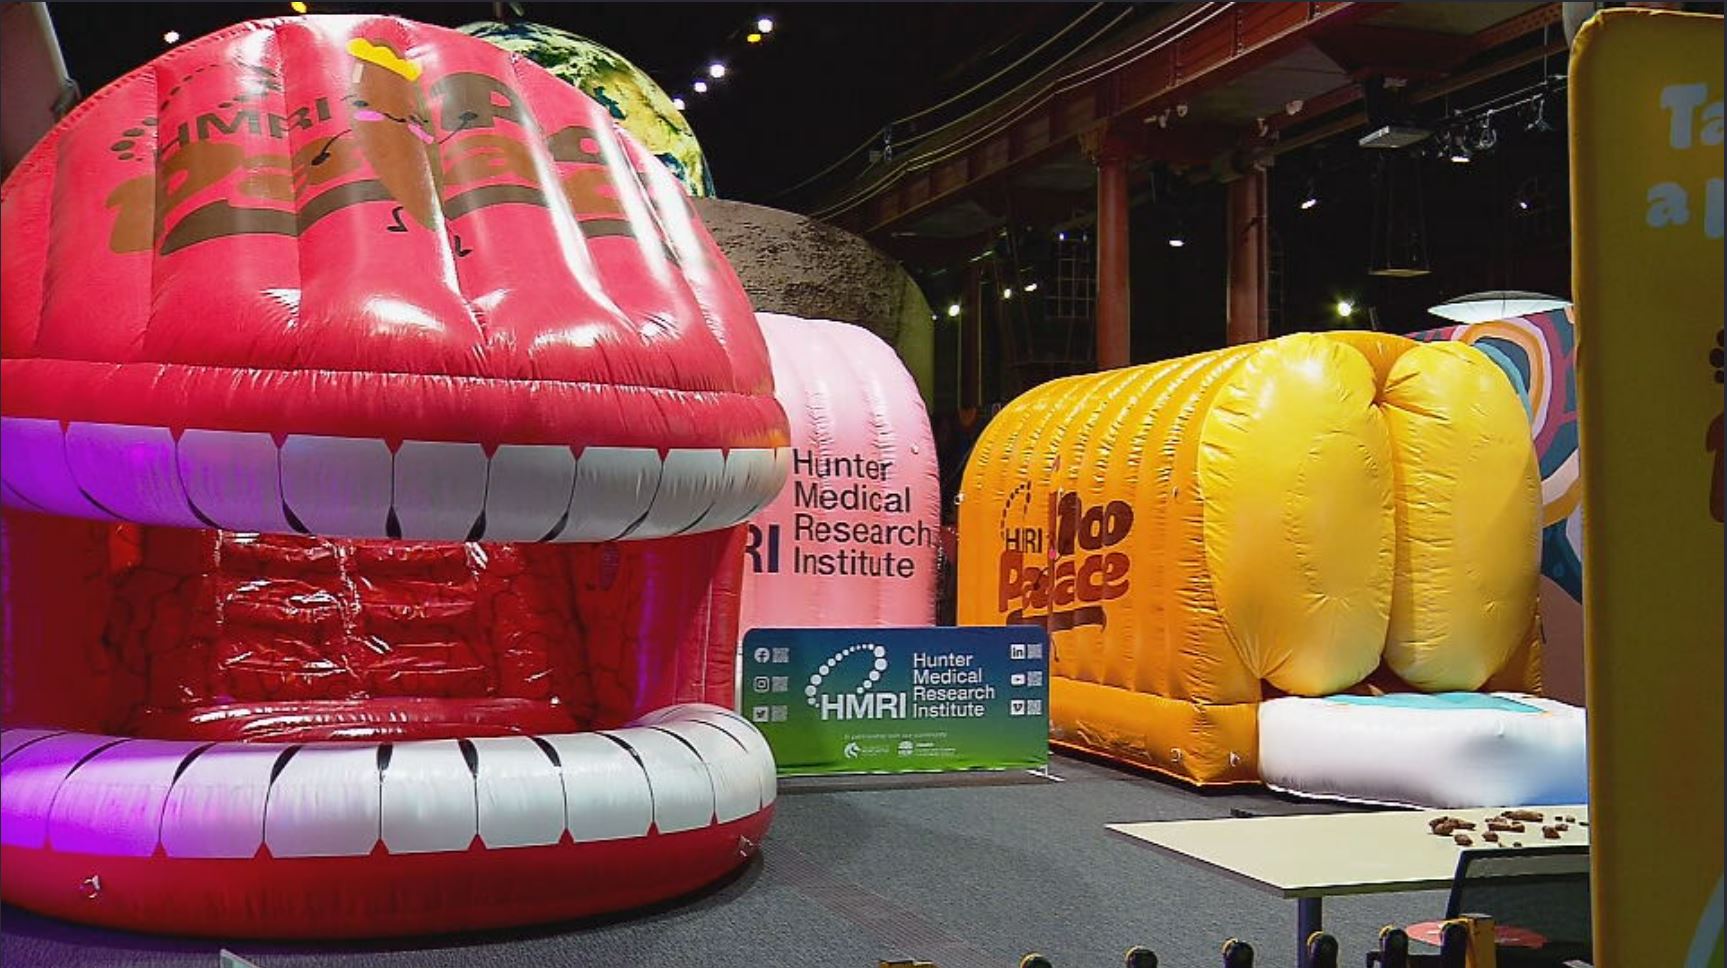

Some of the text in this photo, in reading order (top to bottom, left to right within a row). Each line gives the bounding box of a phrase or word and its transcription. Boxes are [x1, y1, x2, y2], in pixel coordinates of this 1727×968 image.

[158, 97, 332, 152] HMRI
[1647, 181, 1690, 228] a
[793, 448, 893, 481] Hunter
[794, 481, 910, 513] Medical
[794, 513, 932, 546] Research
[1006, 527, 1042, 553] HRI
[794, 546, 915, 578] Institute
[998, 551, 1131, 613] Paace
[913, 652, 973, 668] Hunter
[913, 668, 982, 685] Medical
[913, 684, 996, 701] Research
[821, 692, 906, 720] HMRI
[913, 701, 985, 718] Institute
